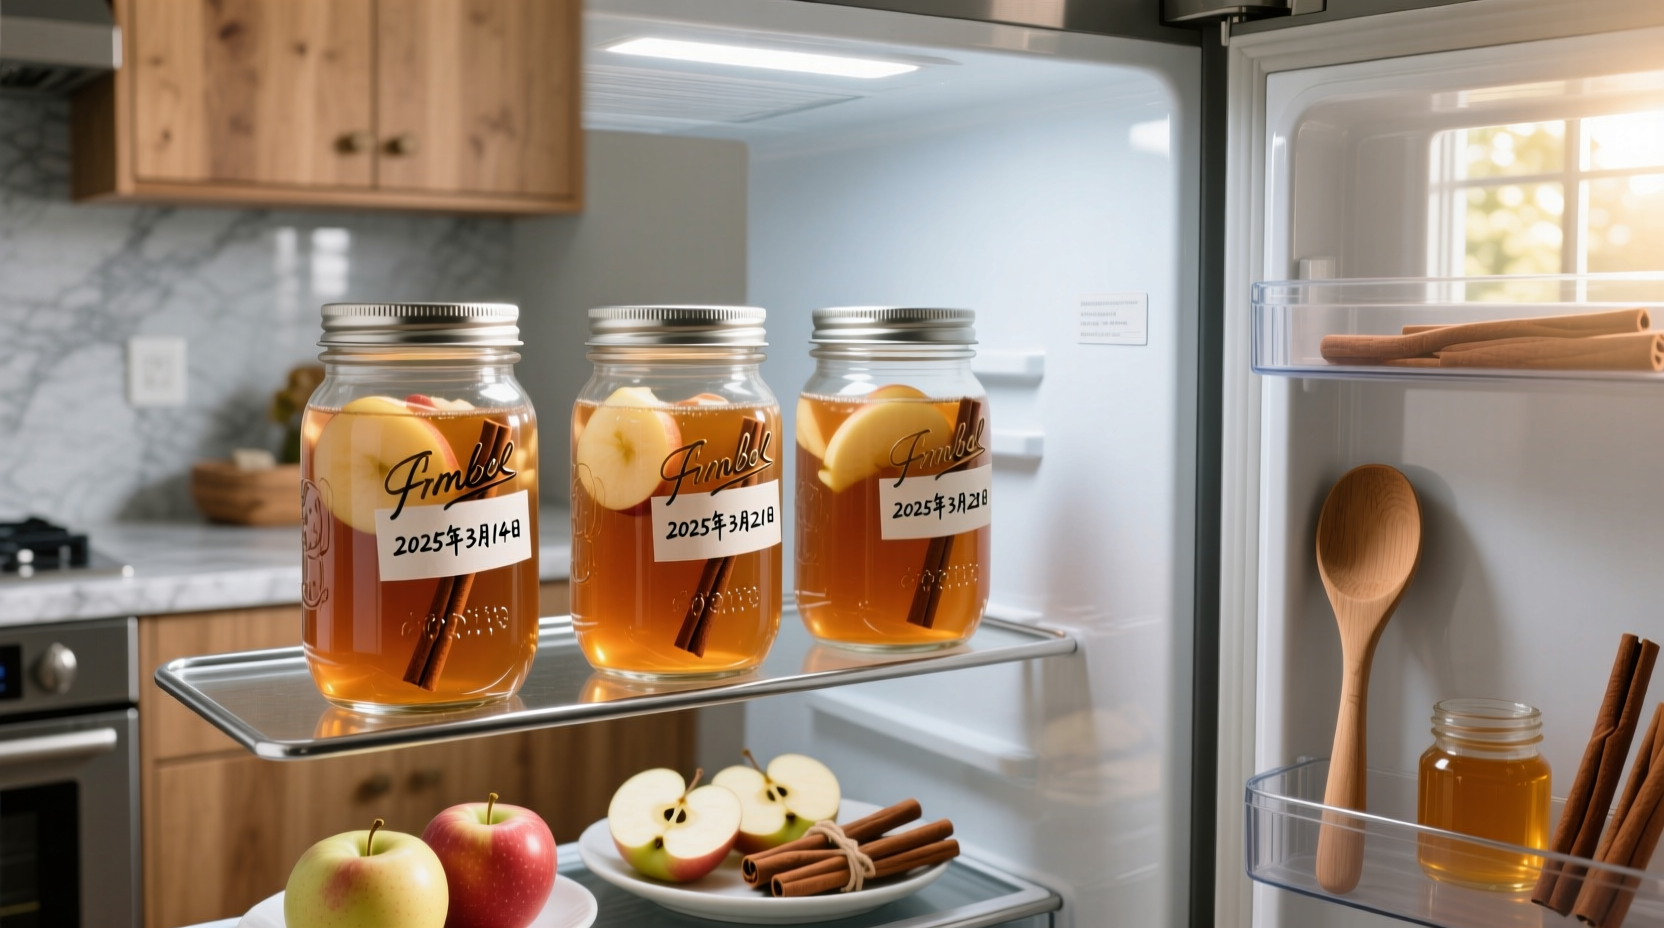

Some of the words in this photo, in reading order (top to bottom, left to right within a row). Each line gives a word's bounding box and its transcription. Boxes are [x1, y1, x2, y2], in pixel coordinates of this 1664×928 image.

[393, 519, 521, 556] 2025年3月14日
[666, 506, 774, 541] 2025年3月21日
